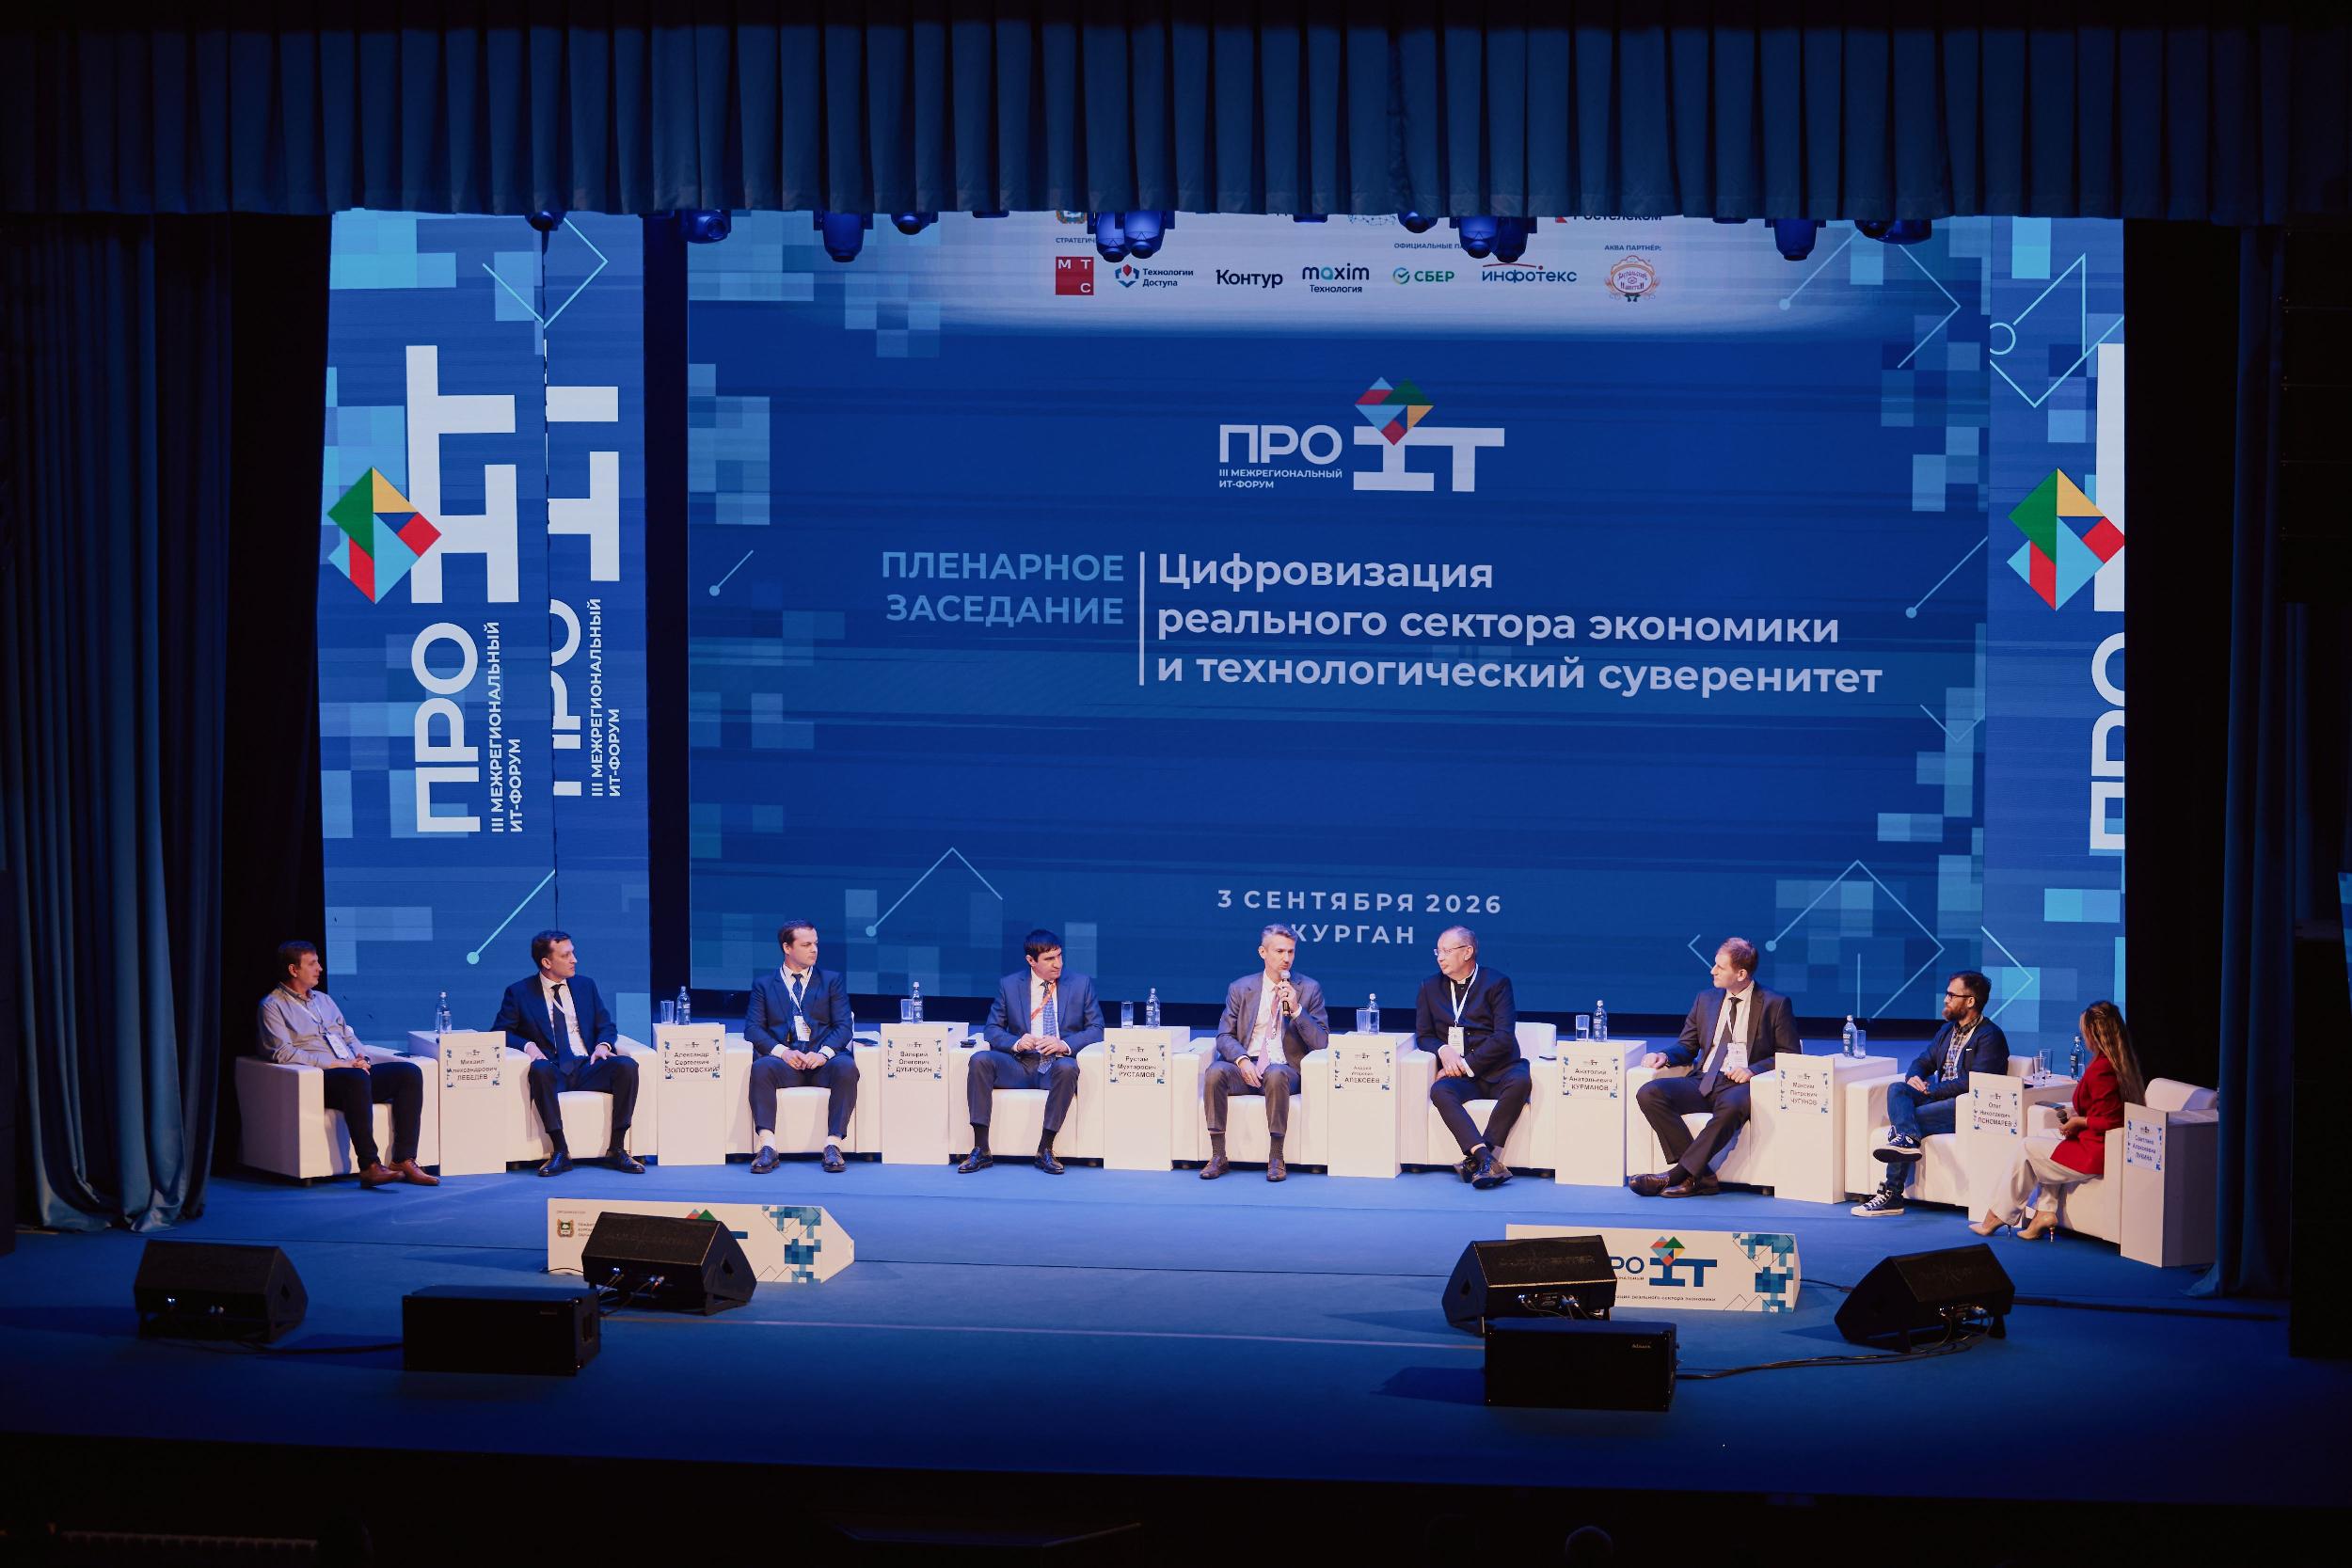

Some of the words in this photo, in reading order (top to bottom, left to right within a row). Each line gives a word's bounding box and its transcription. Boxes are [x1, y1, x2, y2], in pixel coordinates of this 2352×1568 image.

[1057, 259, 1091, 293] МТС
[1142, 268, 1194, 277] Технологии
[1216, 269, 1283, 289] Контур
[1302, 263, 1370, 280] maxim
[1414, 270, 1455, 282] СБЕР
[1482, 270, 1578, 284] инфотекс
[1142, 278, 1178, 289] Доступа
[1310, 284, 1363, 293] Технология
[1219, 424, 1343, 466] ПРО
[1219, 468, 1229, 478] III
[1231, 468, 1343, 479] МЕЖРЕГИОНАЛЬНЫЙ
[1219, 480, 1274, 489] ИТ-ФОРУМ
[882, 551, 1124, 581] ПЛЕНАРНОЕ
[1159, 552, 1494, 593] Цифровизация
[886, 594, 1123, 627] ЗАСЕДАНИЕ
[1158, 609, 1388, 641] реального
[1400, 612, 1575, 646] сектора
[1588, 615, 1838, 644] экономики
[587, 598, 603, 773] МЕЖРЕГИОНАЛЬНЫЙ
[1158, 659, 1183, 682] и
[1196, 656, 1584, 690] технологический
[1598, 665, 1883, 699] суверенитет
[486, 622, 504, 811] МЕЖРЕГИОНАЛЬНЫЙ
[411, 622, 481, 832] ПРО
[608, 708, 621, 797] ИТ-ФОРУМ
[508, 738, 524, 832] ИТ-ФОРУМ
[591, 779, 603, 797] III
[490, 815, 504, 832] III
[1217, 890, 1232, 908] 3
[1244, 890, 1413, 912] СЕНТЯБРЯ
[1425, 894, 1501, 914] 2026
[1291, 923, 1414, 944] КУРГАН
[1789, 1089, 1818, 1098] Петрович
[1790, 1098, 1818, 1106] ЧУГУНОВ
[1610, 1256, 1645, 1275] РО
